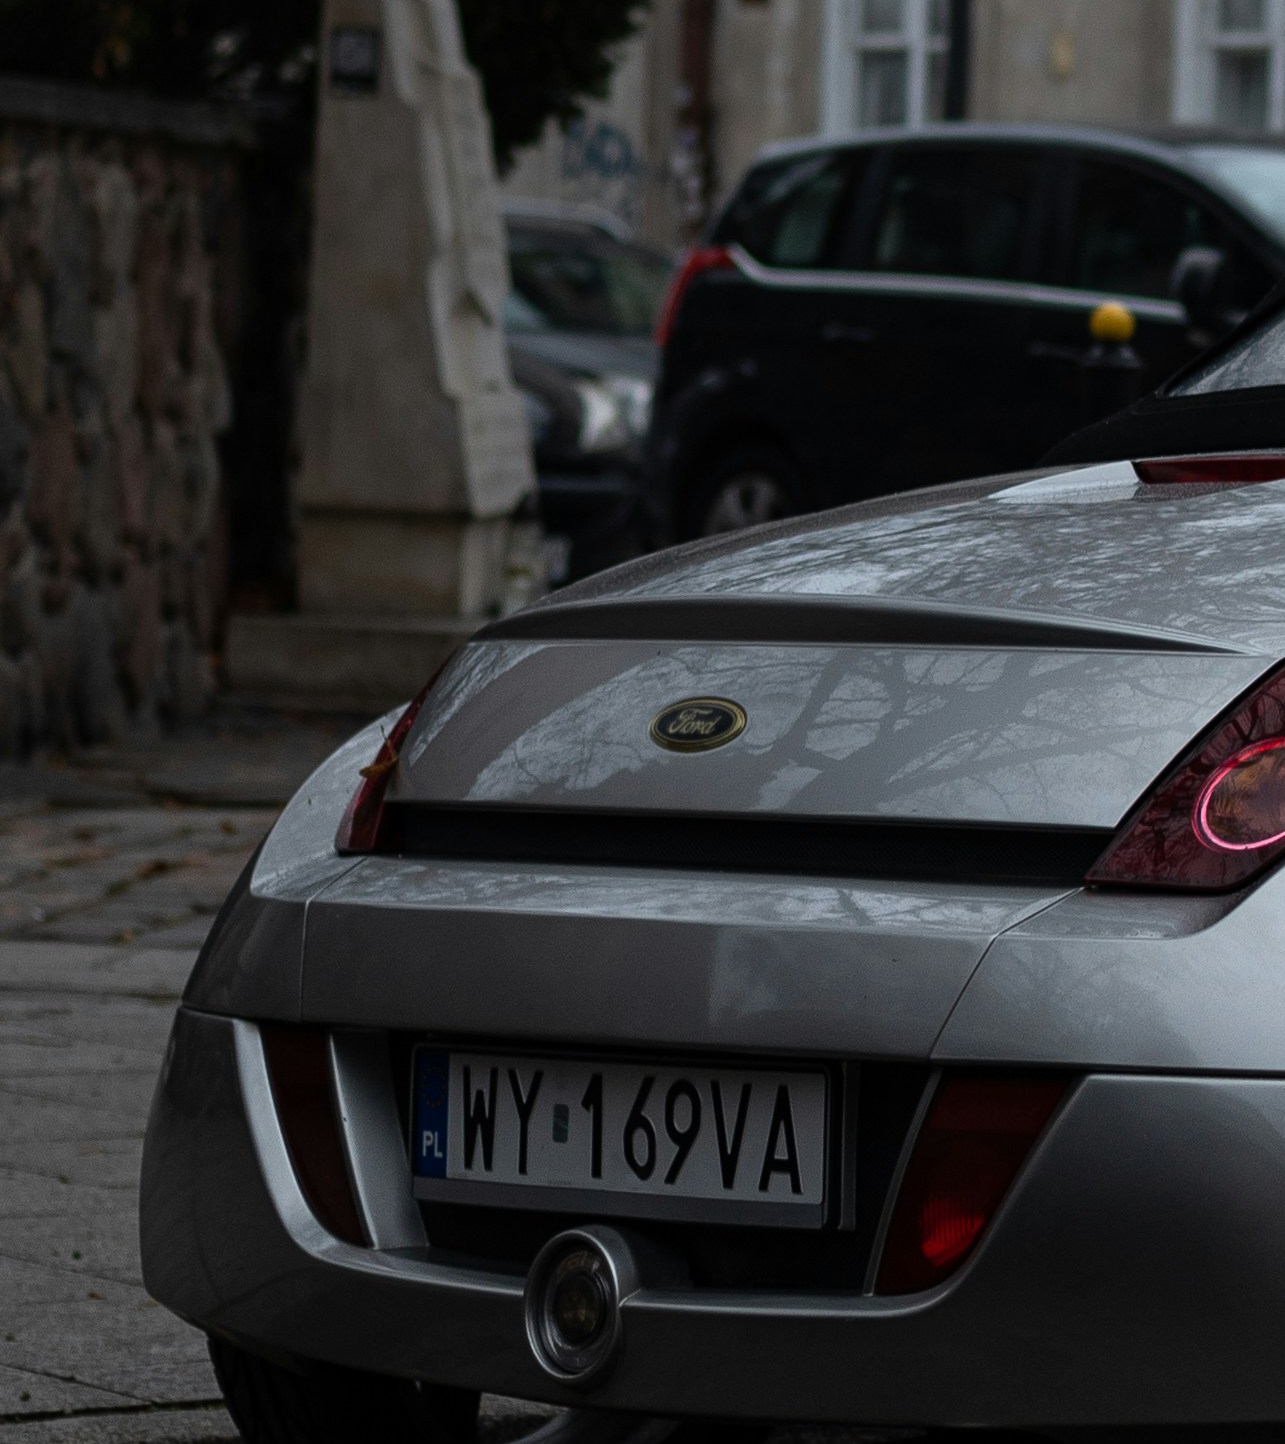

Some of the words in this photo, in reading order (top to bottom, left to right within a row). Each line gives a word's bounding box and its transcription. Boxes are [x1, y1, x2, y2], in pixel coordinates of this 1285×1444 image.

[667, 708, 722, 735] Ford
[421, 1130, 444, 1159] PL
[462, 1065, 544, 1176] WY
[581, 1071, 804, 1196] 169VA
